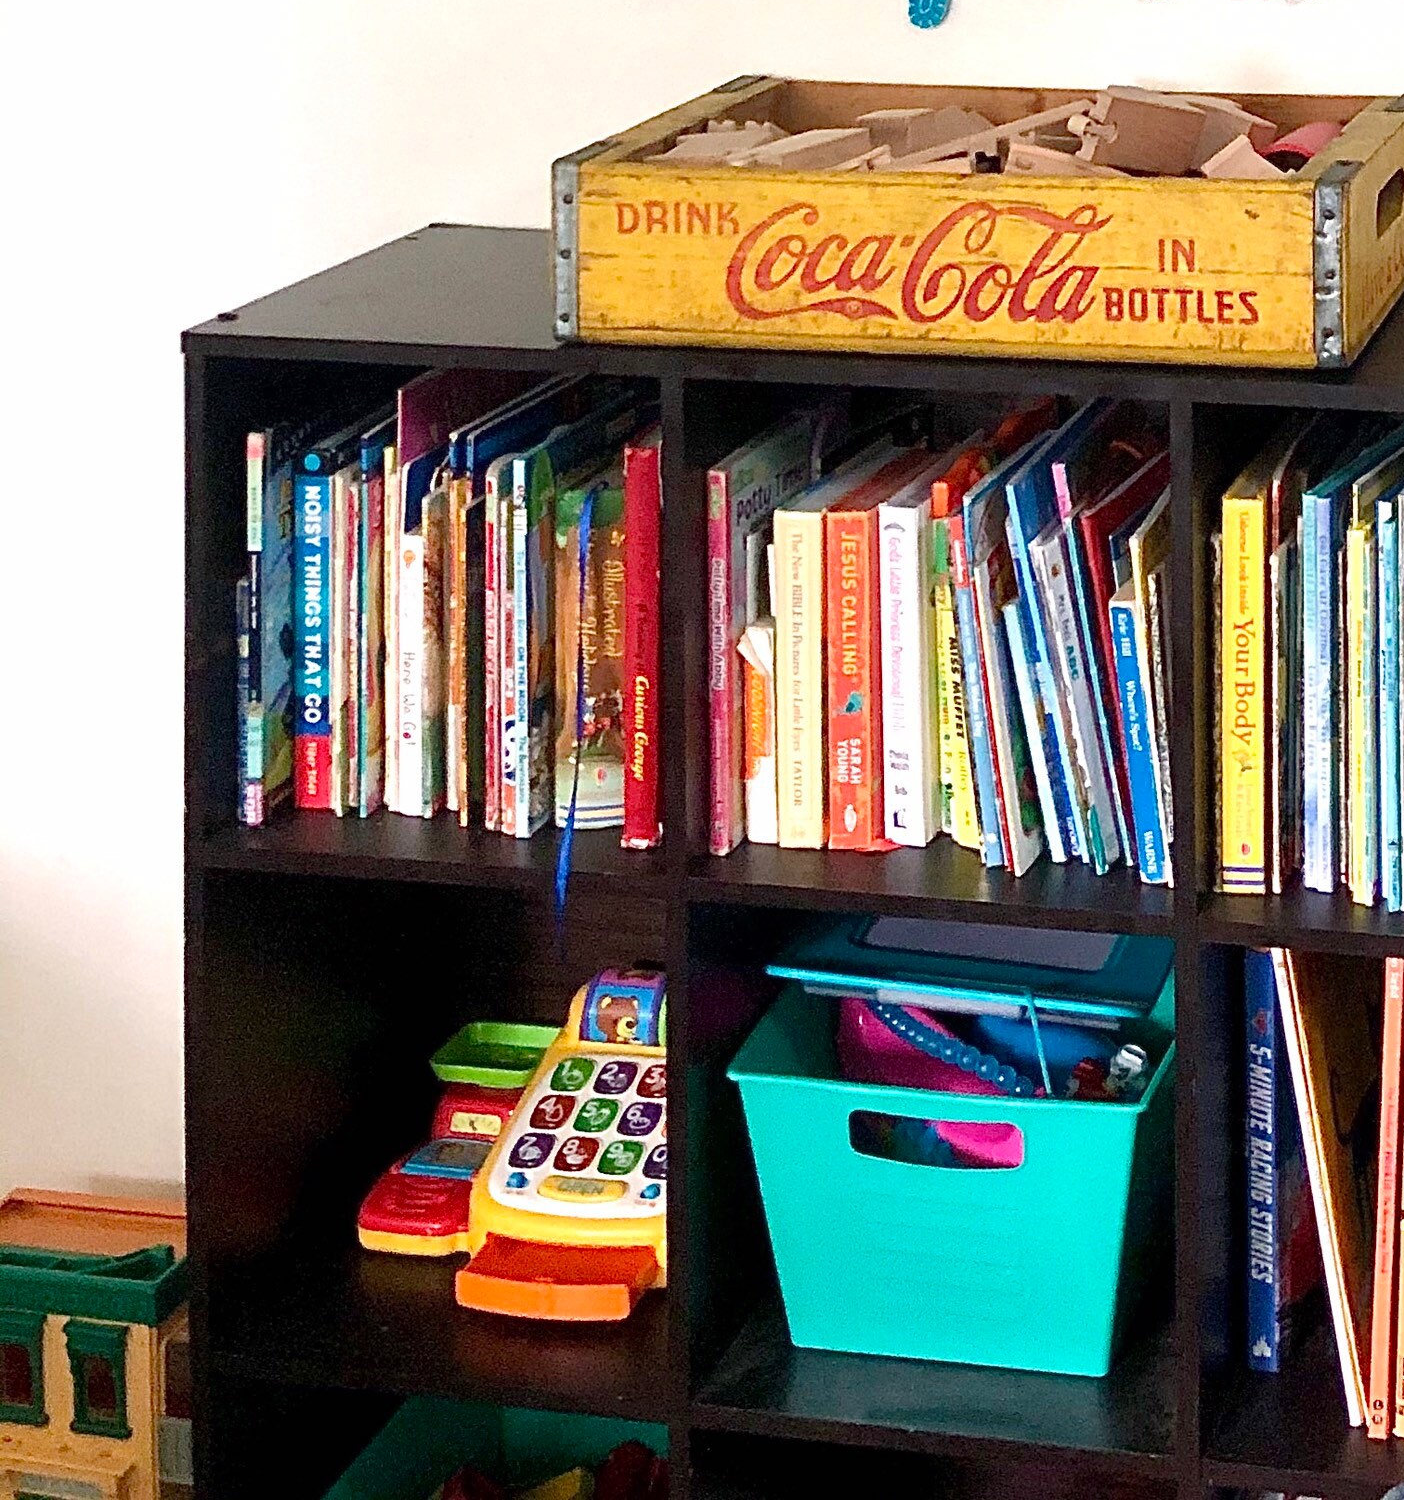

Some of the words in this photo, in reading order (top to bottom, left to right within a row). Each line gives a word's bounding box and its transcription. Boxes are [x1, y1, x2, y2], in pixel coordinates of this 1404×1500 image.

[615, 200, 743, 237] DRINK
[723, 199, 1111, 326] Coca-Cola
[1156, 236, 1198, 274] IN
[1104, 290, 1260, 327] BOTTLES
[303, 485, 322, 547] NOISY
[840, 531, 860, 590] JESUS
[303, 553, 322, 627] THINGS
[602, 560, 625, 657] Illustrated
[793, 585, 804, 618] BIBLE
[840, 595, 858, 675] CALLING
[1116, 613, 1129, 634] Eric
[303, 633, 322, 688] THAT
[402, 652, 416, 685] Here
[518, 645, 526, 662] ON
[949, 637, 961, 674] MISS
[1121, 637, 1133, 656] Hill
[1233, 618, 1257, 677] Your
[518, 665, 527, 686] THE
[303, 693, 322, 723] GO
[518, 689, 527, 722] MOON
[633, 676, 650, 730] Curious
[952, 680, 965, 739] MUFFET
[1124, 680, 1139, 721] Where's
[1231, 681, 1257, 746] Body
[402, 721, 417, 745] Go!
[630, 731, 650, 781] George
[837, 739, 850, 783] YOUNG
[849, 738, 862, 785] SARAH
[793, 760, 803, 806] TAYLOR
[1143, 830, 1158, 874] WARNE
[600, 1063, 619, 1080] 2
[644, 1067, 662, 1084] 3
[1249, 1043, 1273, 1135] 5-MINUTE
[538, 1099, 555, 1114] 4
[581, 1101, 599, 1119] 5
[626, 1104, 644, 1120] 6
[518, 1135, 538, 1154] 7
[562, 1138, 580, 1156] 8
[606, 1142, 625, 1160] 9
[1250, 1135, 1274, 1205] RACING
[1250, 1206, 1274, 1284] STORIES
